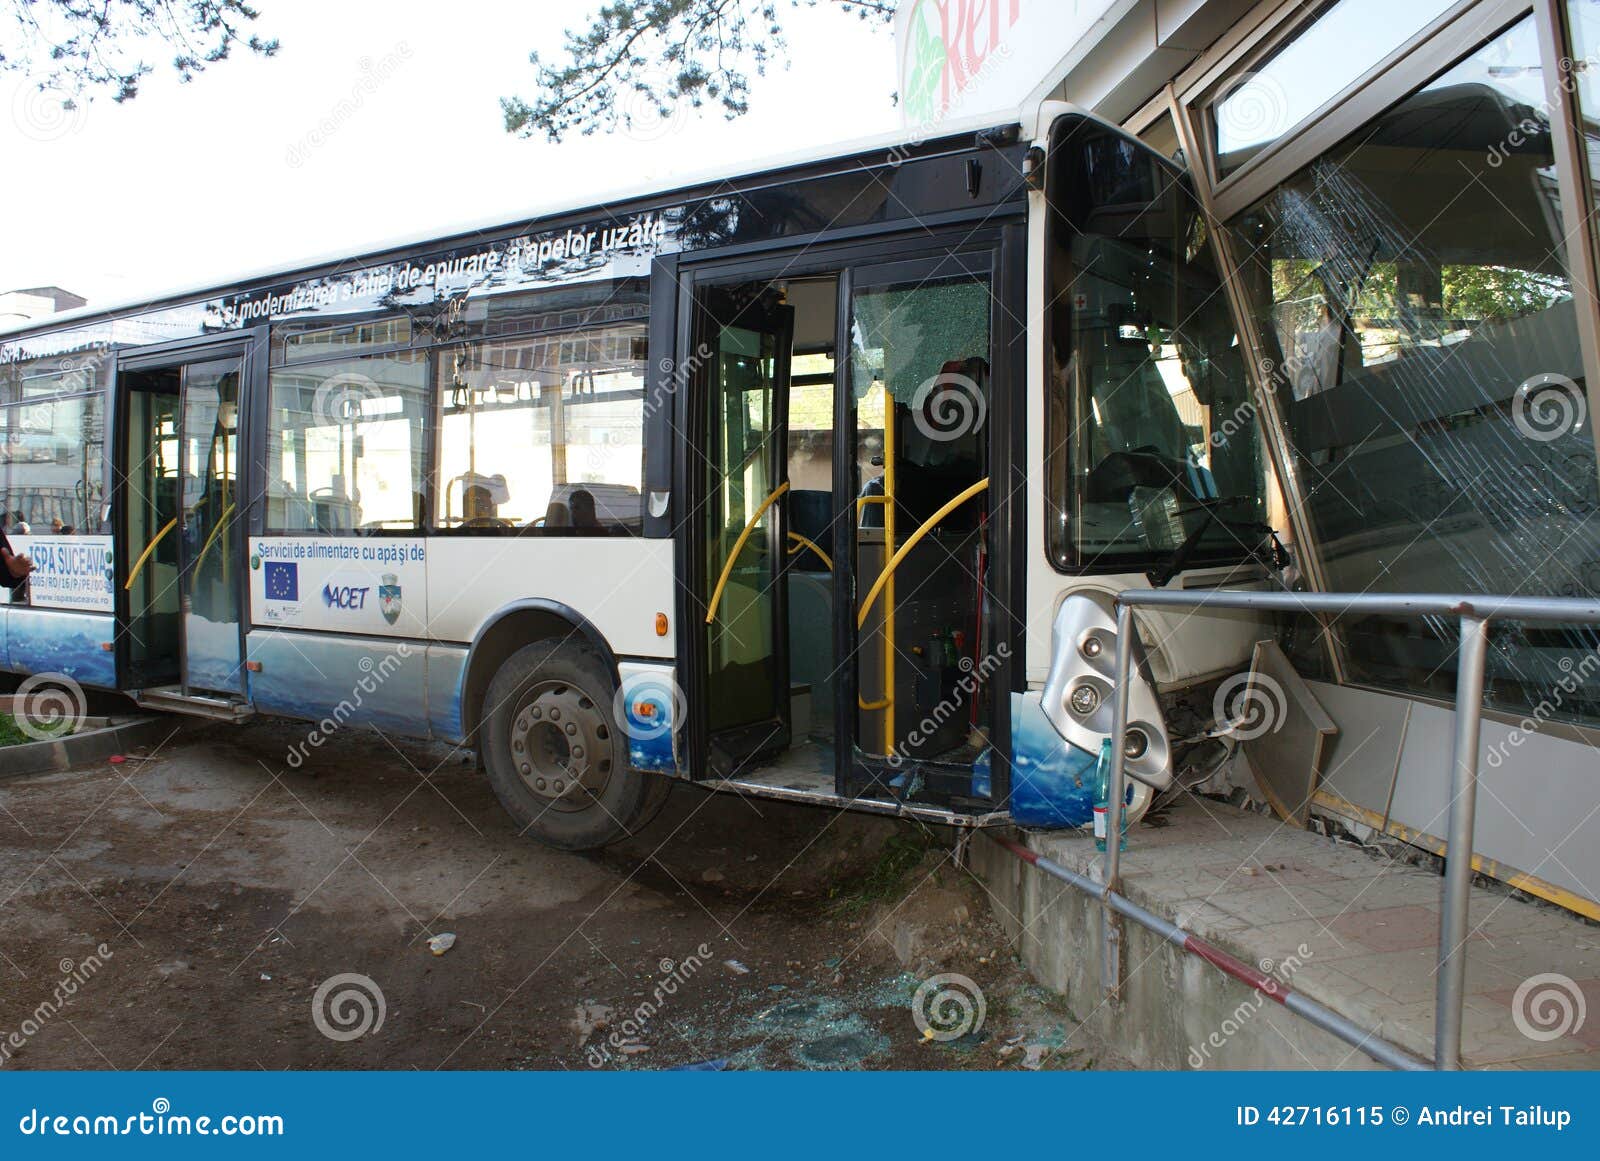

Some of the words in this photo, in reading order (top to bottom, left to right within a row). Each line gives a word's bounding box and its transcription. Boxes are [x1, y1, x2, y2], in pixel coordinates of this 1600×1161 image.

[240, 282, 339, 320] modernizarea
[399, 263, 420, 290] de
[425, 251, 498, 297] epurare
[509, 246, 520, 266] a
[526, 229, 597, 269] apelor
[601, 216, 665, 251] uzate
[58, 546, 106, 577] SUCEAVA
[307, 542, 360, 559] alimentare
[362, 546, 376, 561] cu
[377, 543, 397, 566] apă
[410, 543, 425, 561] de
[328, 586, 370, 610] ACET
